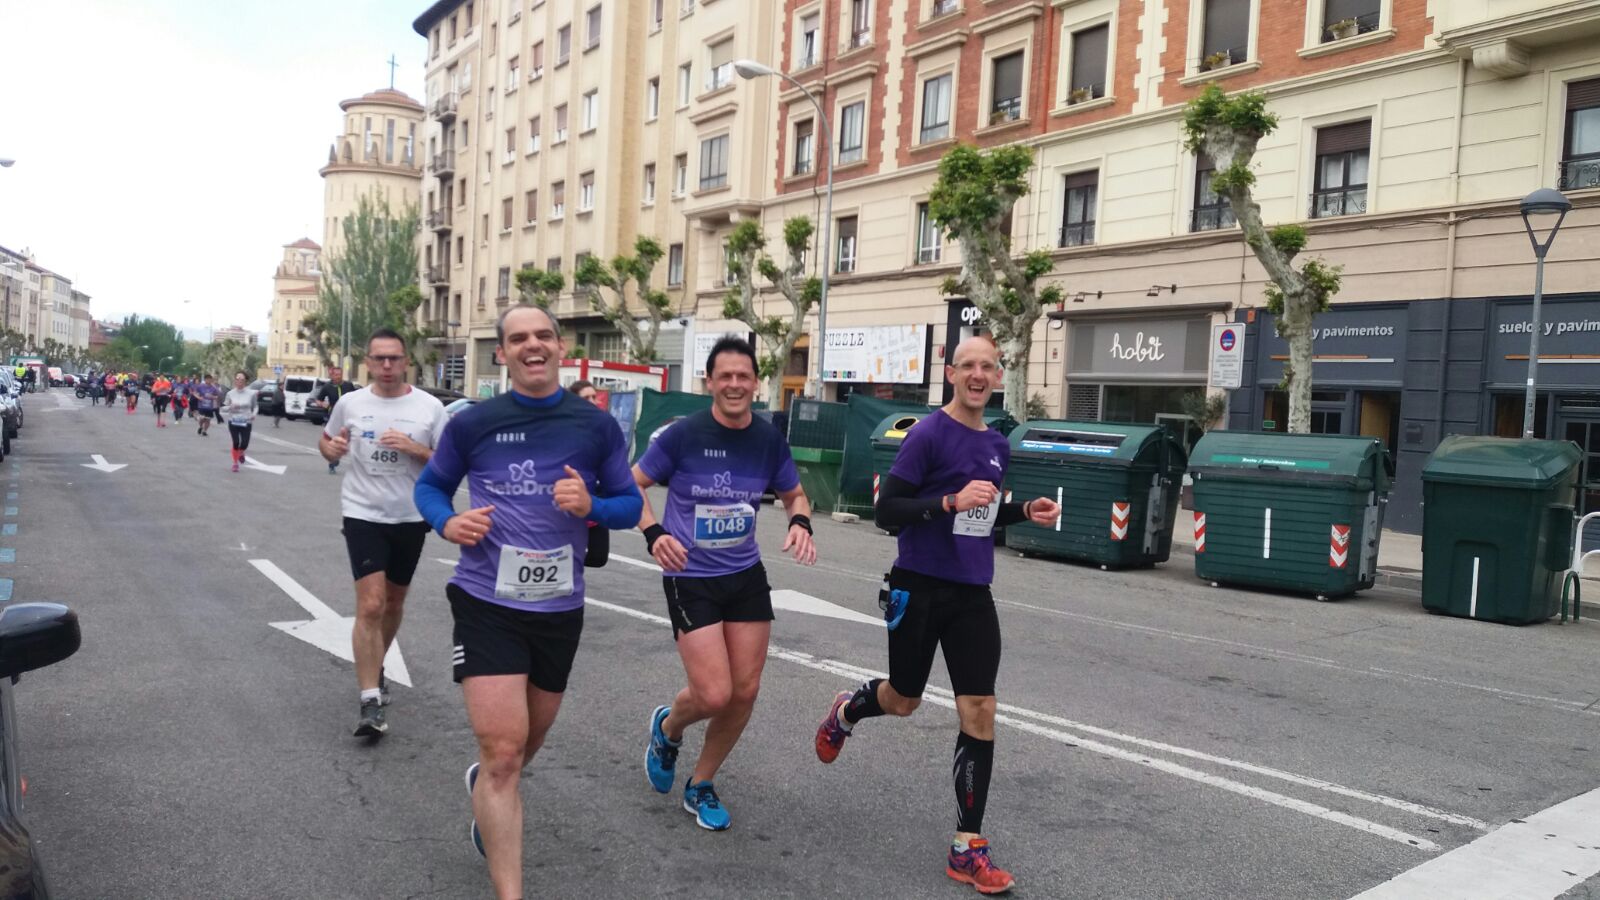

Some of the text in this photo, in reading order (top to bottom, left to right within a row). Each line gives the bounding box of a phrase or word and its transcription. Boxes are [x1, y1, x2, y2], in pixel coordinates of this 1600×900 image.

[1322, 325, 1394, 339] pavimentos
[1499, 321, 1540, 333] suelo
[1544, 322, 1553, 336] y
[371, 450, 398, 463] 468
[705, 517, 746, 534] 1048
[518, 565, 558, 583] 092
